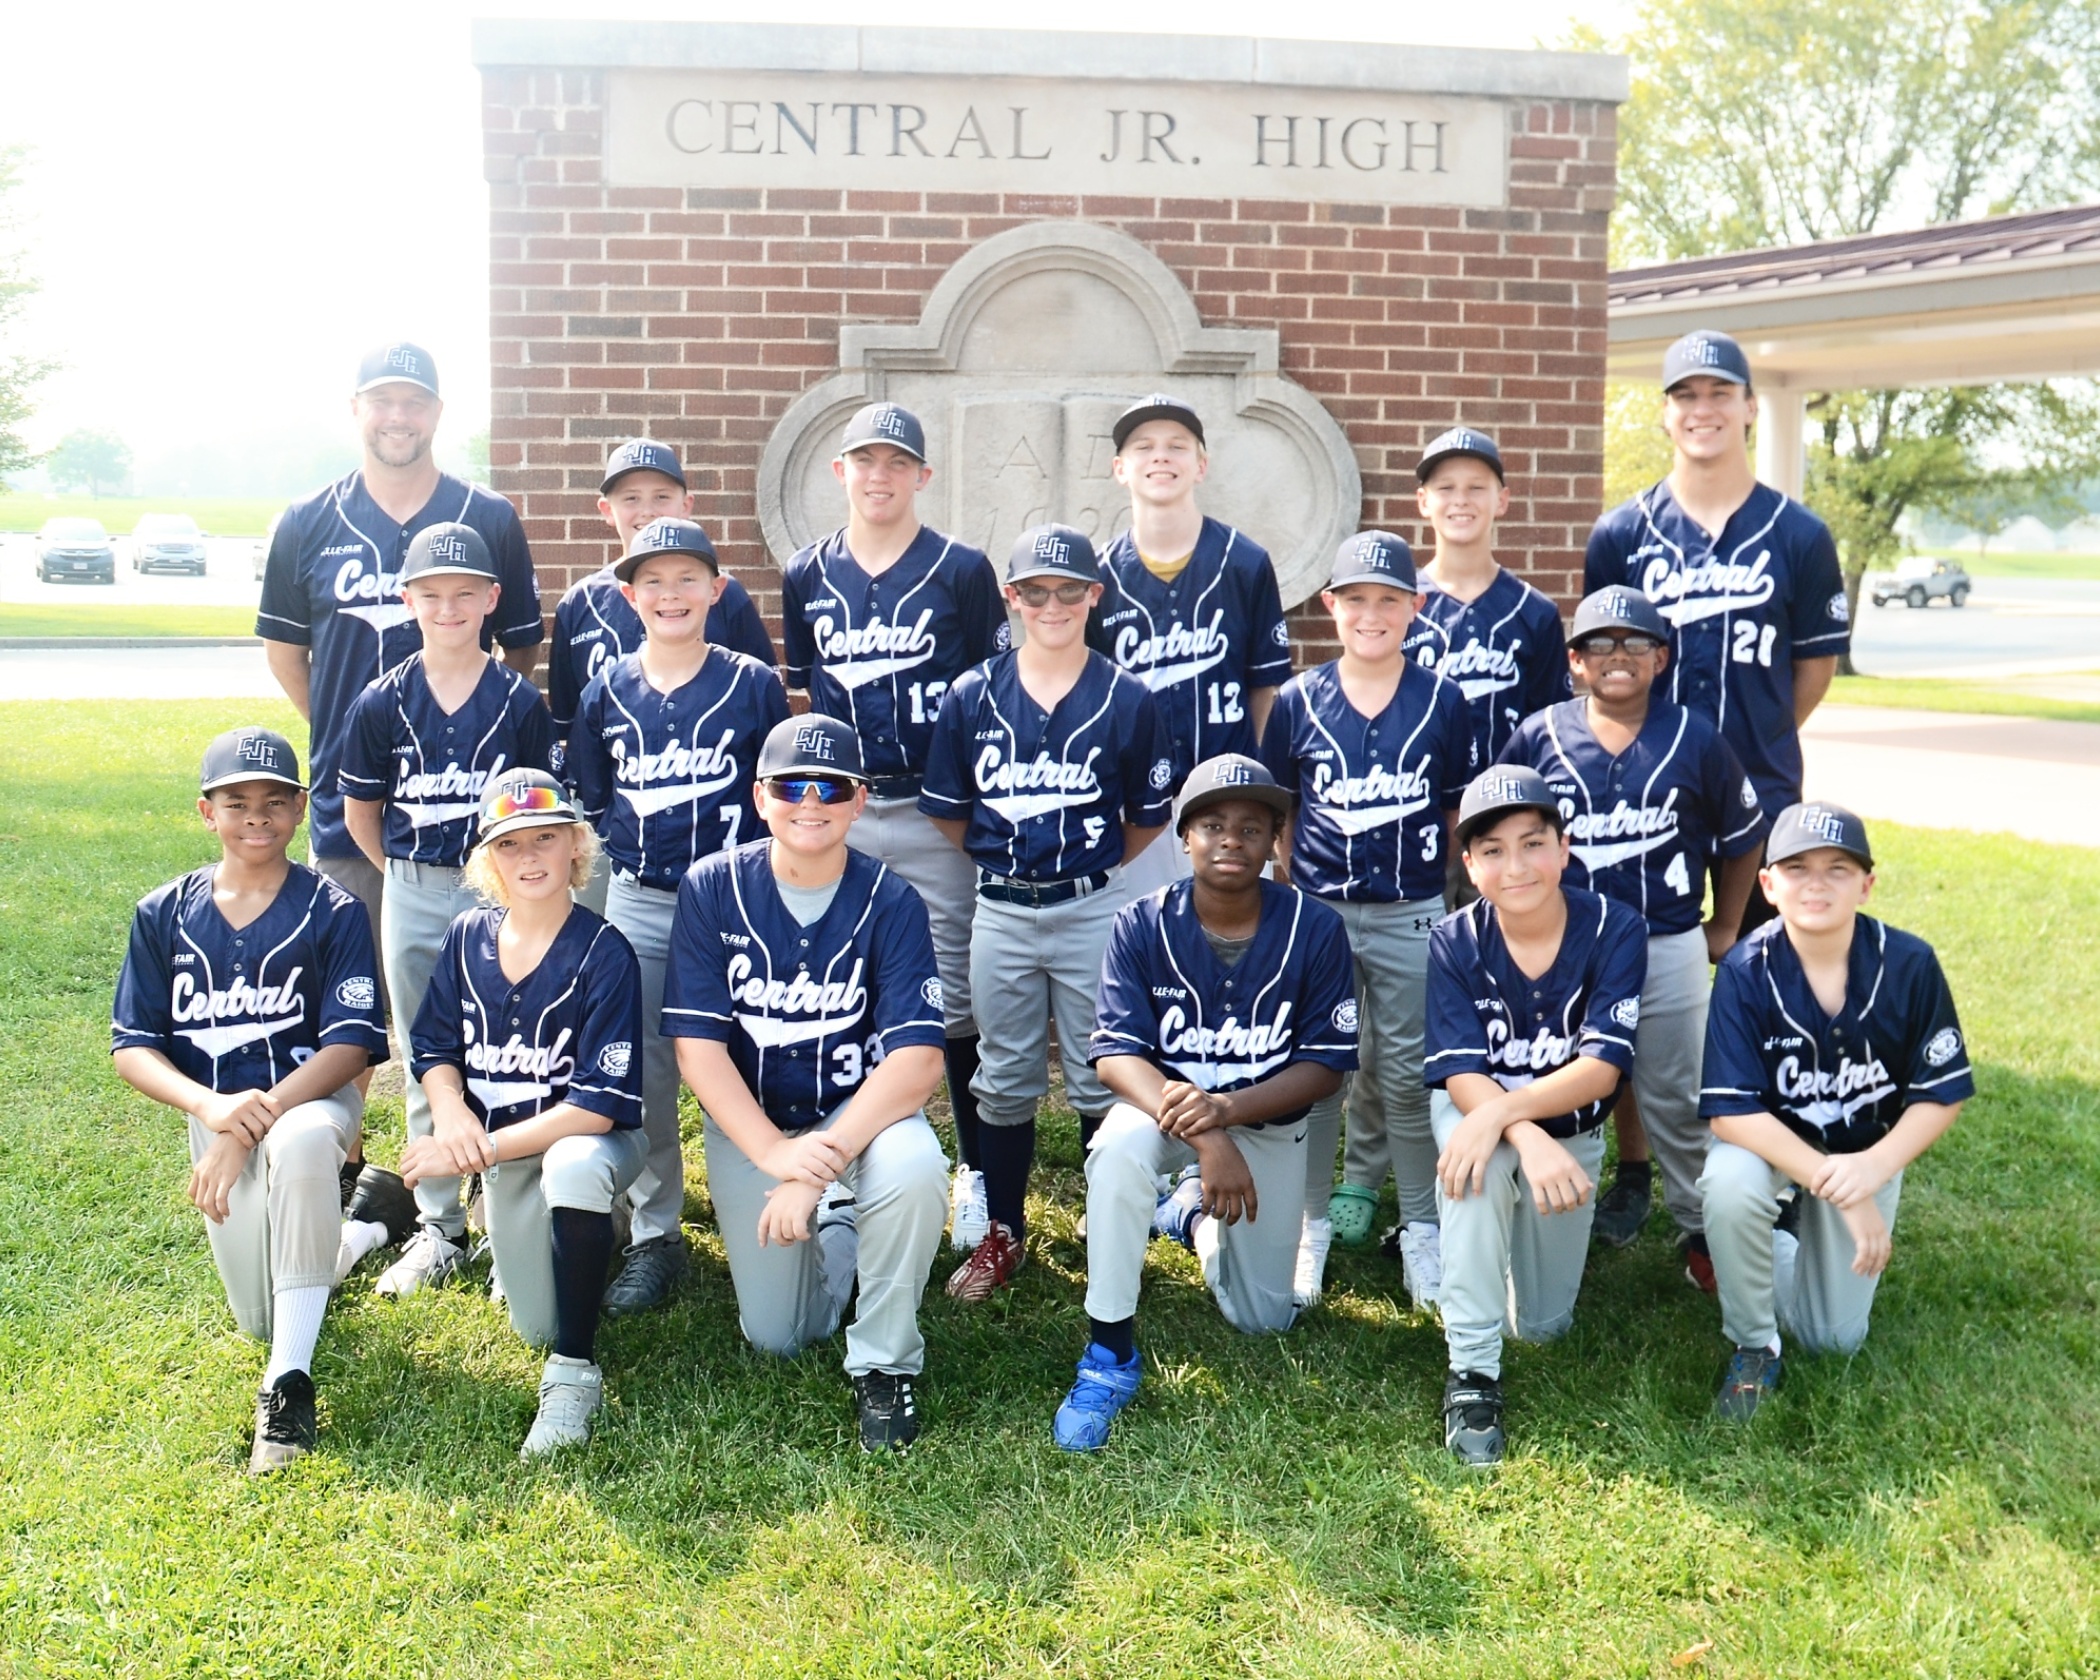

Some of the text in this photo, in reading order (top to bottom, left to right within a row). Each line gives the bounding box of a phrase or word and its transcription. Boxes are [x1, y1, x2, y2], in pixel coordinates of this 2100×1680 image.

[665, 98, 1450, 174] CENTRAL JR. HIGH
[428, 533, 467, 562] CJH
[1032, 532, 1070, 564] CJH
[334, 559, 402, 603] Cent
[1643, 549, 1773, 603] Central
[814, 608, 935, 660] Central
[1115, 608, 1227, 669] Central
[1732, 619, 1777, 667] 21
[908, 681, 948, 724] 13
[1208, 681, 1245, 724] 12
[236, 734, 278, 769] CJH
[611, 728, 736, 783] Central
[792, 724, 835, 761] CJH
[394, 753, 507, 800] Central
[975, 744, 1102, 793] Central
[1312, 753, 1432, 804] Central
[720, 804, 742, 850] 7
[1083, 815, 1106, 849] 5
[1557, 787, 1679, 839] Central
[1419, 824, 1439, 862] 3
[1664, 852, 1690, 896] 4
[174, 953, 196, 964] FAIR
[171, 966, 304, 1023] Central
[727, 953, 866, 1013] Central
[1159, 1001, 1292, 1057] Central
[1486, 1018, 1578, 1070] Centr
[831, 1033, 885, 1087] 33
[1777, 1054, 1890, 1099] Centra
